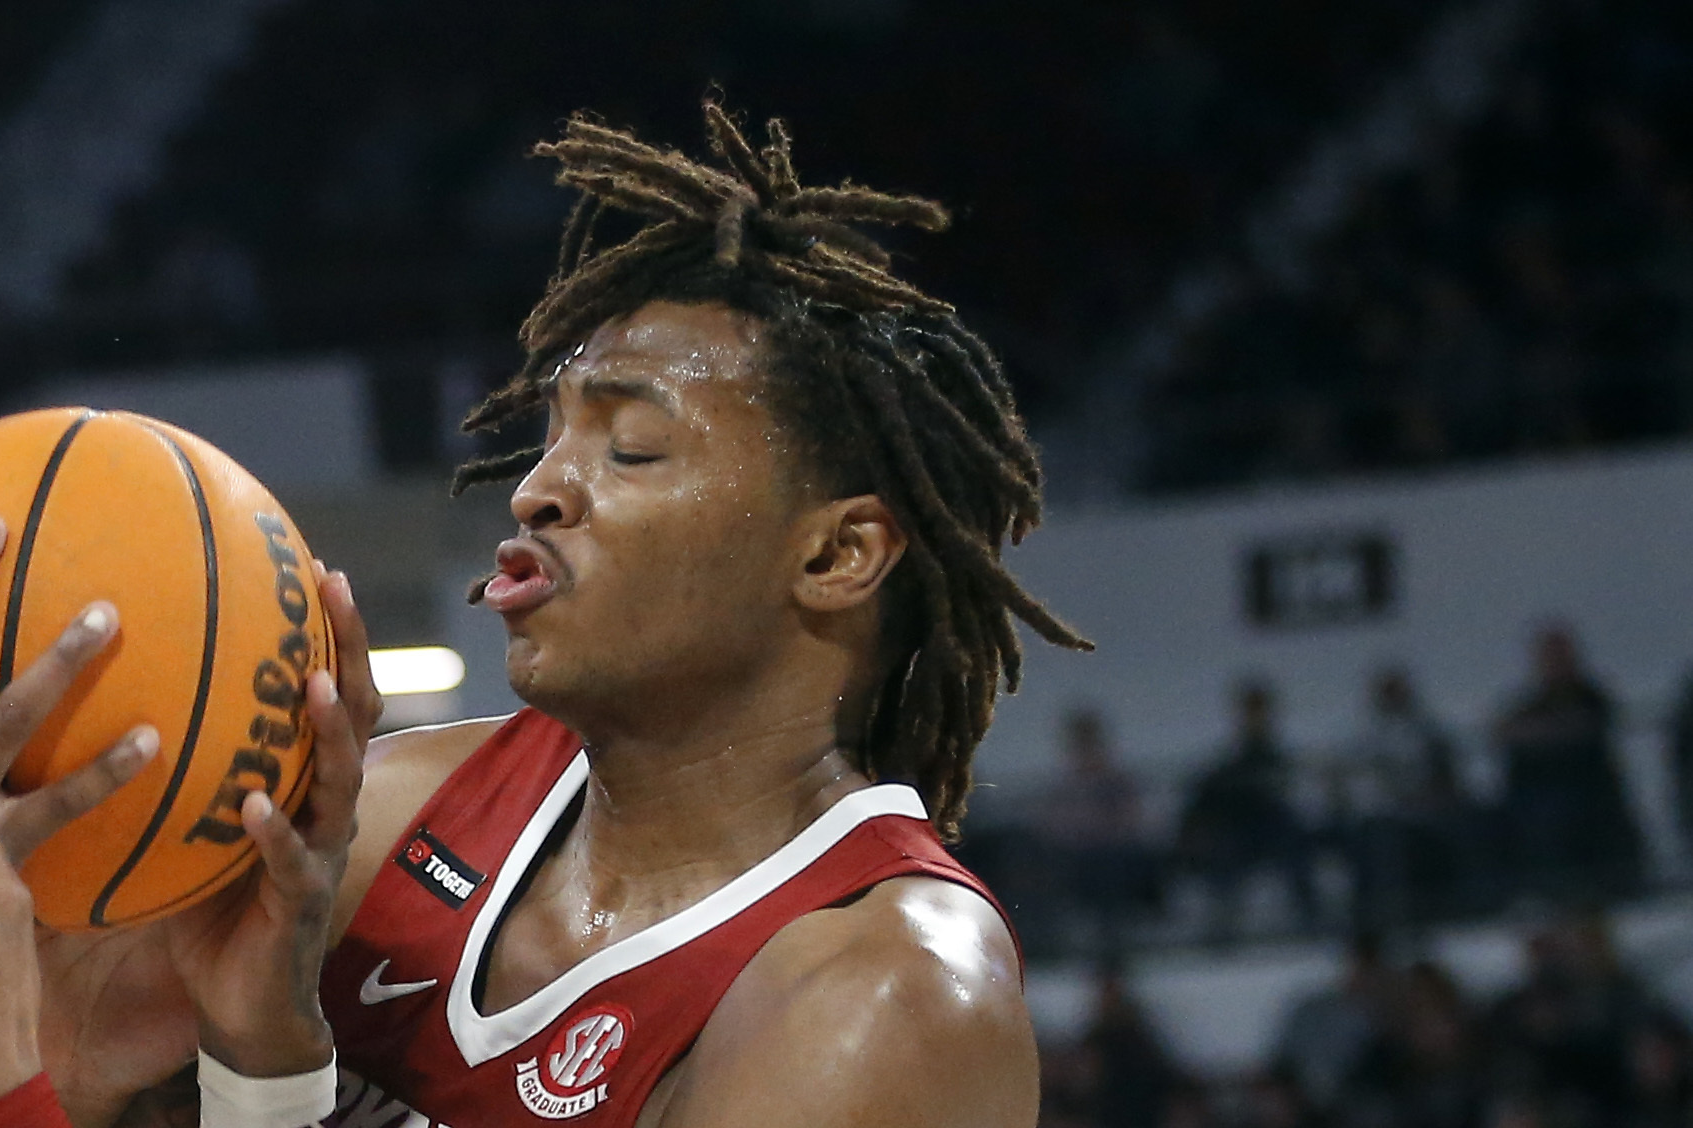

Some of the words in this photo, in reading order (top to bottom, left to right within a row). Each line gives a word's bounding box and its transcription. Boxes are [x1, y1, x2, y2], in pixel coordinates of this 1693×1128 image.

[184, 511, 312, 844] Wilson
[548, 1014, 625, 1088] SEC
[521, 1077, 587, 1115] GRADUATE
